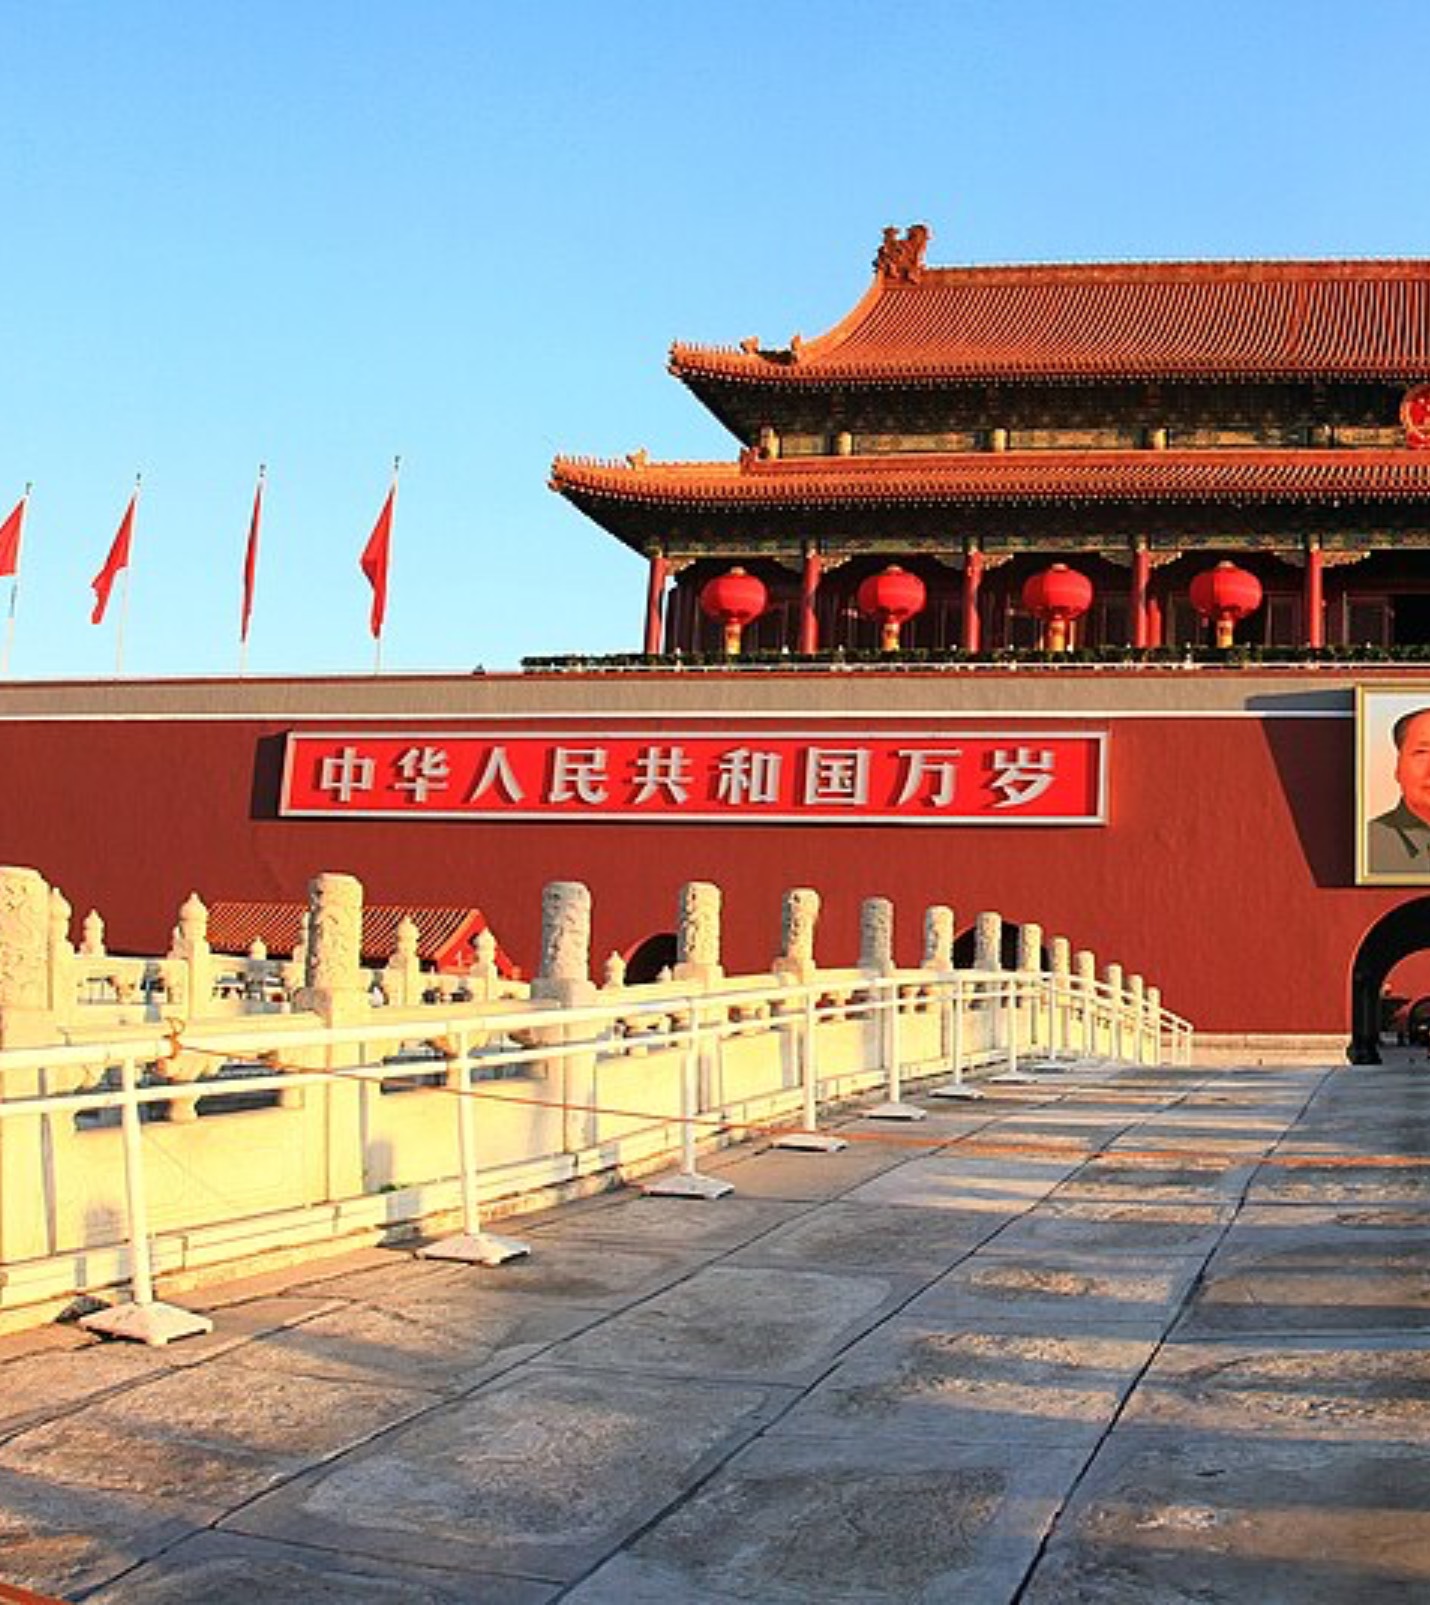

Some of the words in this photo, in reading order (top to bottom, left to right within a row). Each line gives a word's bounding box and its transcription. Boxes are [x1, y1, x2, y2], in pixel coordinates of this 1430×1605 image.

[319, 746, 1057, 808] 中华人民共和国万岁
